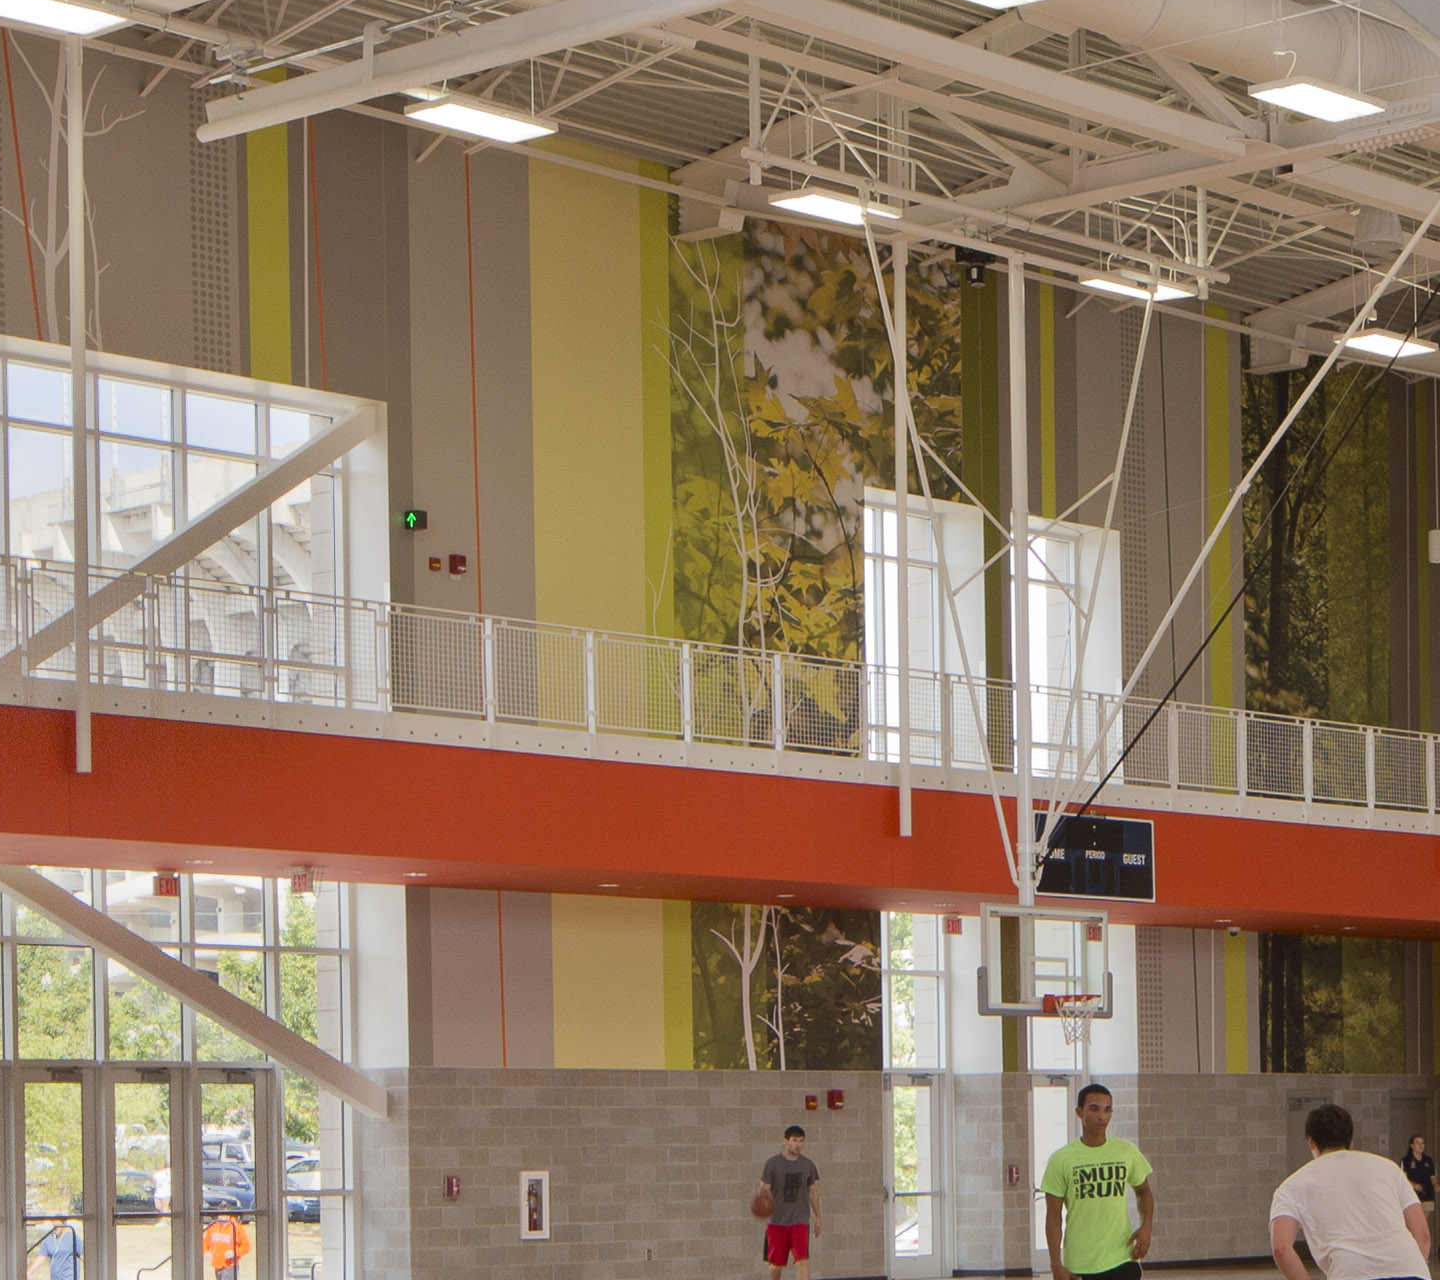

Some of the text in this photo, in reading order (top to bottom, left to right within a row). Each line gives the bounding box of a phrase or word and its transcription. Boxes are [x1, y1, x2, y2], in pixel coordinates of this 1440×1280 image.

[1046, 848, 1146, 865] ME PERIOD GUEST
[159, 878, 177, 894] EXIT
[1079, 1165, 1127, 1183] MUD
[1080, 1181, 1126, 1199] RUN
